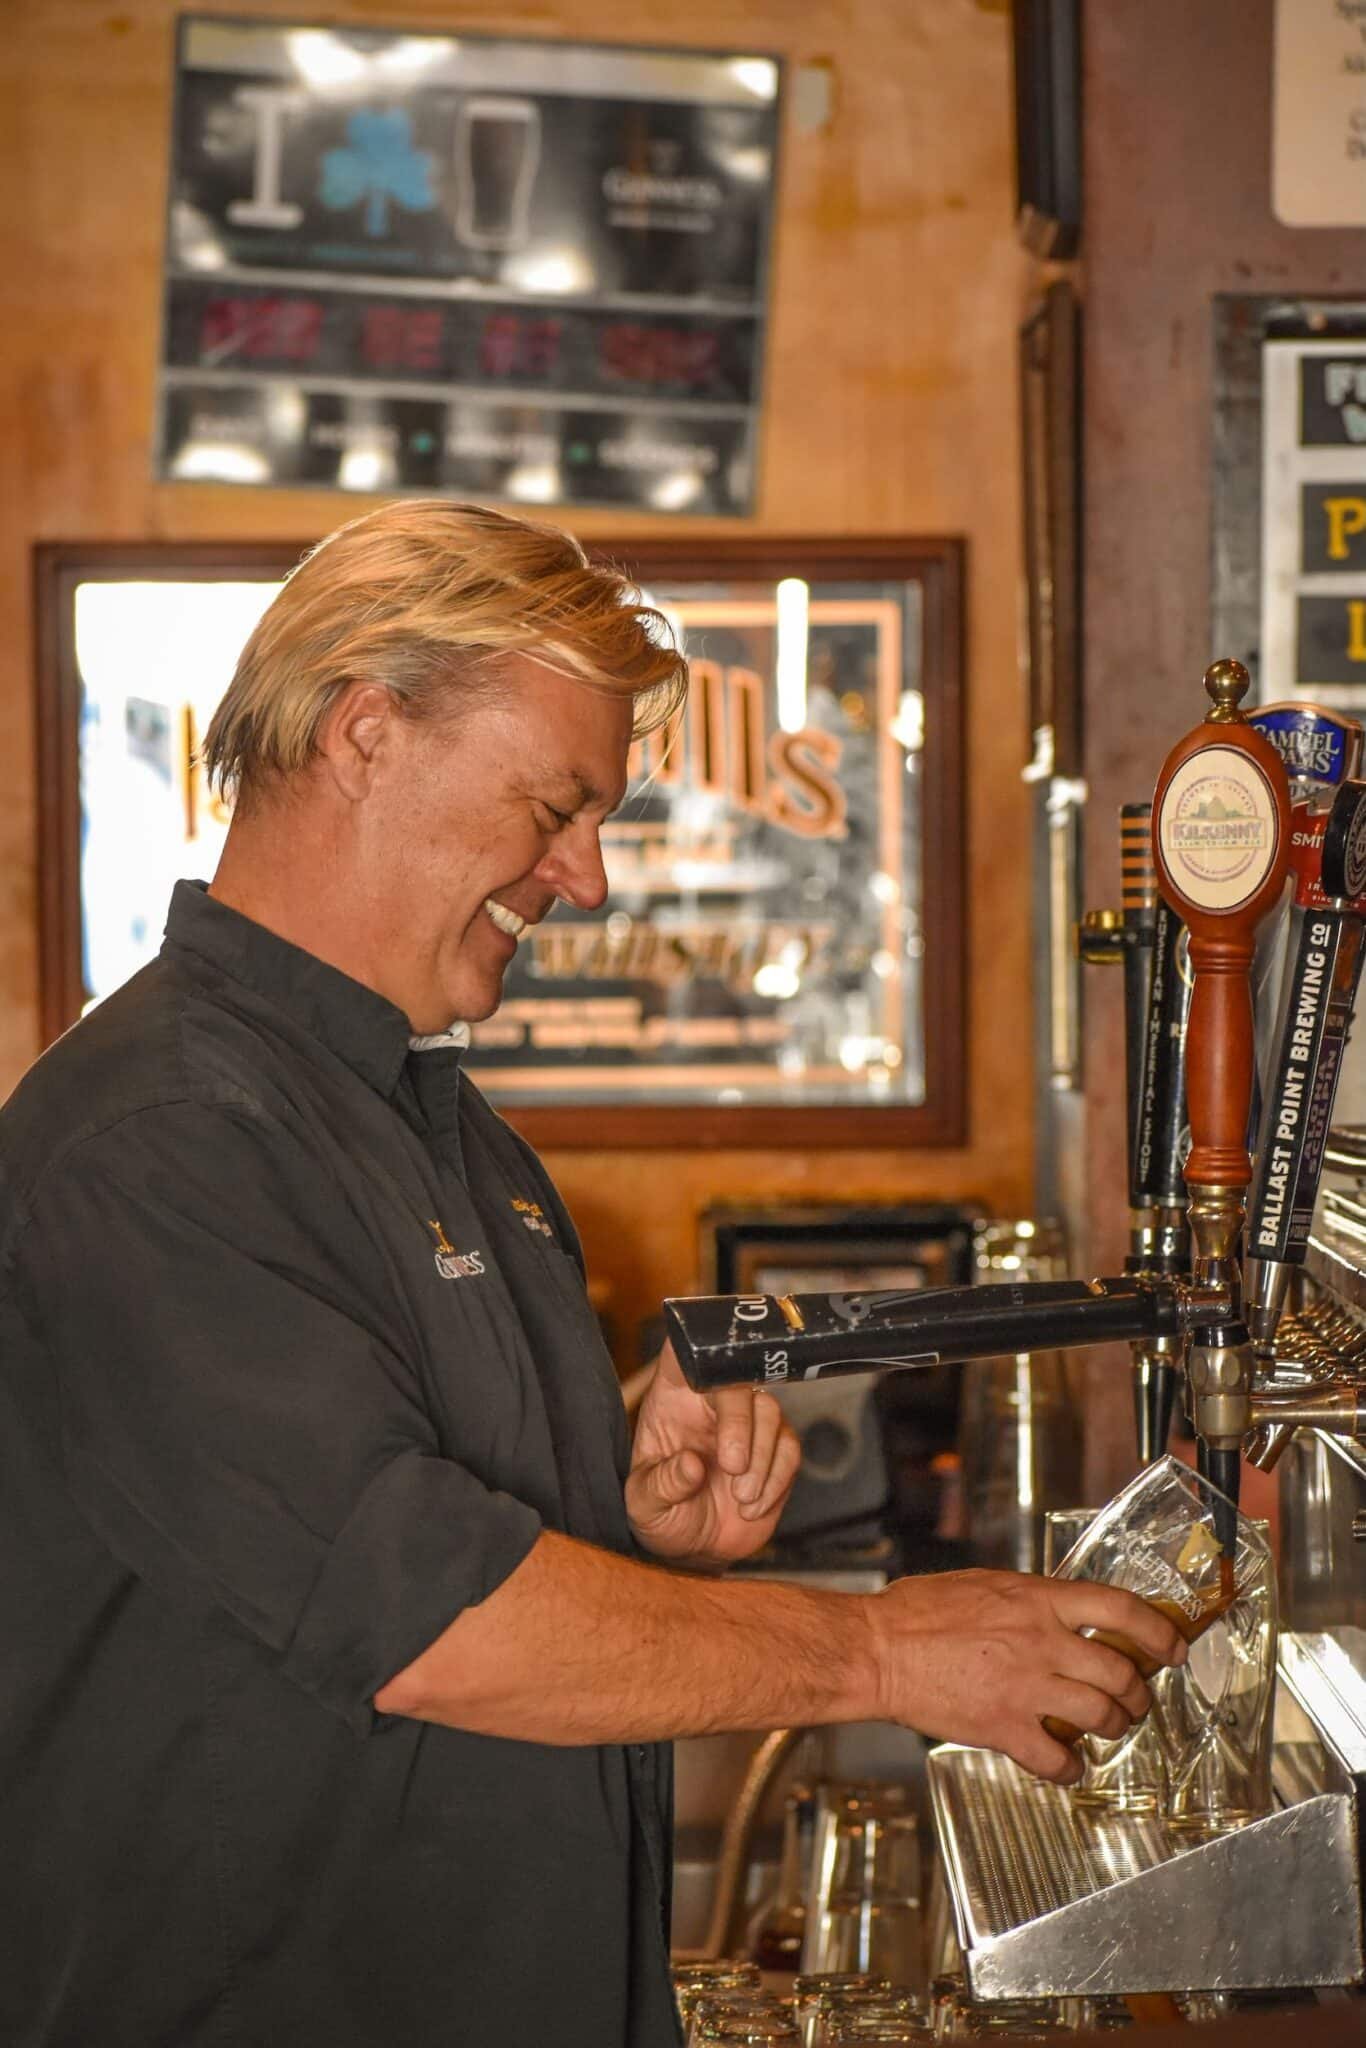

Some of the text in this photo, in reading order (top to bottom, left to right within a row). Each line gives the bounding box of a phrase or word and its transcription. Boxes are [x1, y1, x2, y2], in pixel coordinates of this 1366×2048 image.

[1173, 822, 1263, 842] KILKENNY
[1310, 923, 1328, 946] CO
[1290, 951, 1327, 1062] BREWING
[1276, 1067, 1305, 1141] POINT
[1140, 1117, 1152, 1183] STOUT
[1258, 1146, 1292, 1247] BALLAST
